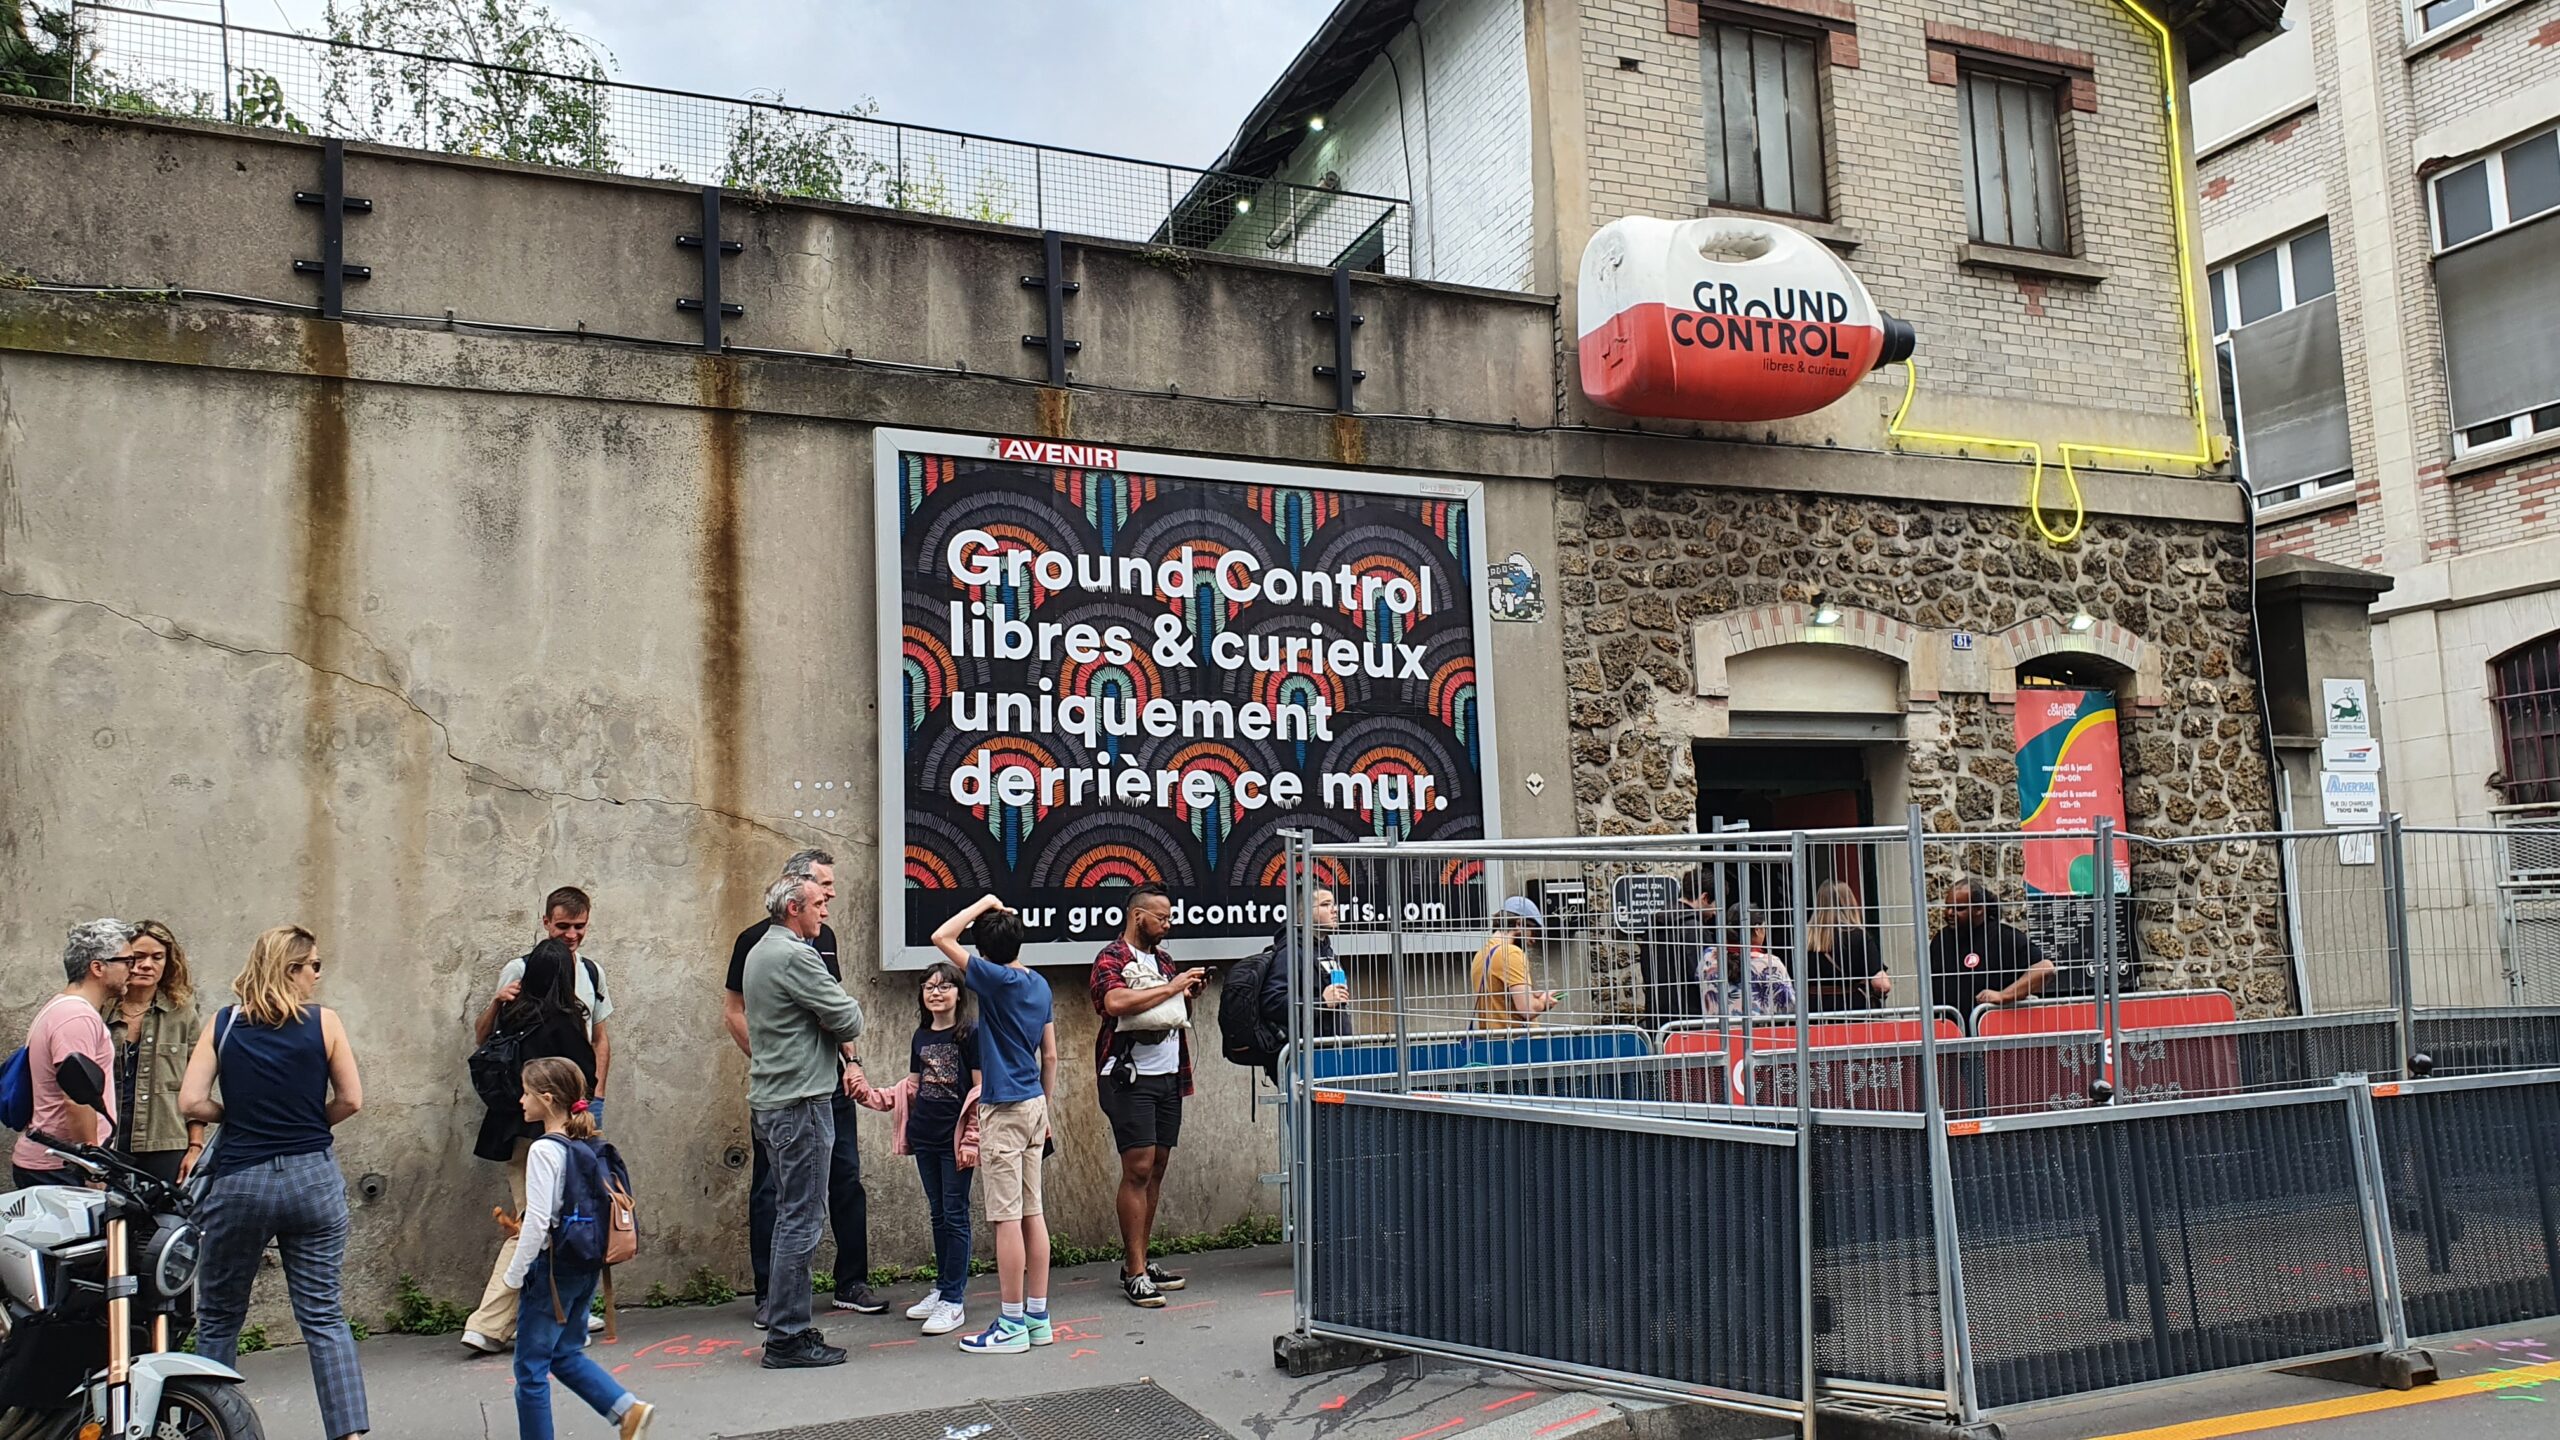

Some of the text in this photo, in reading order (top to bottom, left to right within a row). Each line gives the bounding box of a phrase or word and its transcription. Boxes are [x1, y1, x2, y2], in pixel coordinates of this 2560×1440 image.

[1693, 281, 1848, 324] GROUND
[1671, 313, 1849, 360] CONTROL
[1763, 358, 1848, 378] libres & curieux
[1003, 439, 1115, 468] AVENIR
[947, 529, 1433, 616] Ground Control
[950, 600, 1430, 681] libres & curieux
[951, 677, 1333, 752] uniquement
[950, 748, 1449, 811] derrière ce mur.
[2076, 763, 2093, 774] jeudi
[2041, 790, 2068, 798] vendredi
[2075, 790, 2098, 798] samedi
[2056, 817, 2087, 825] dimanche
